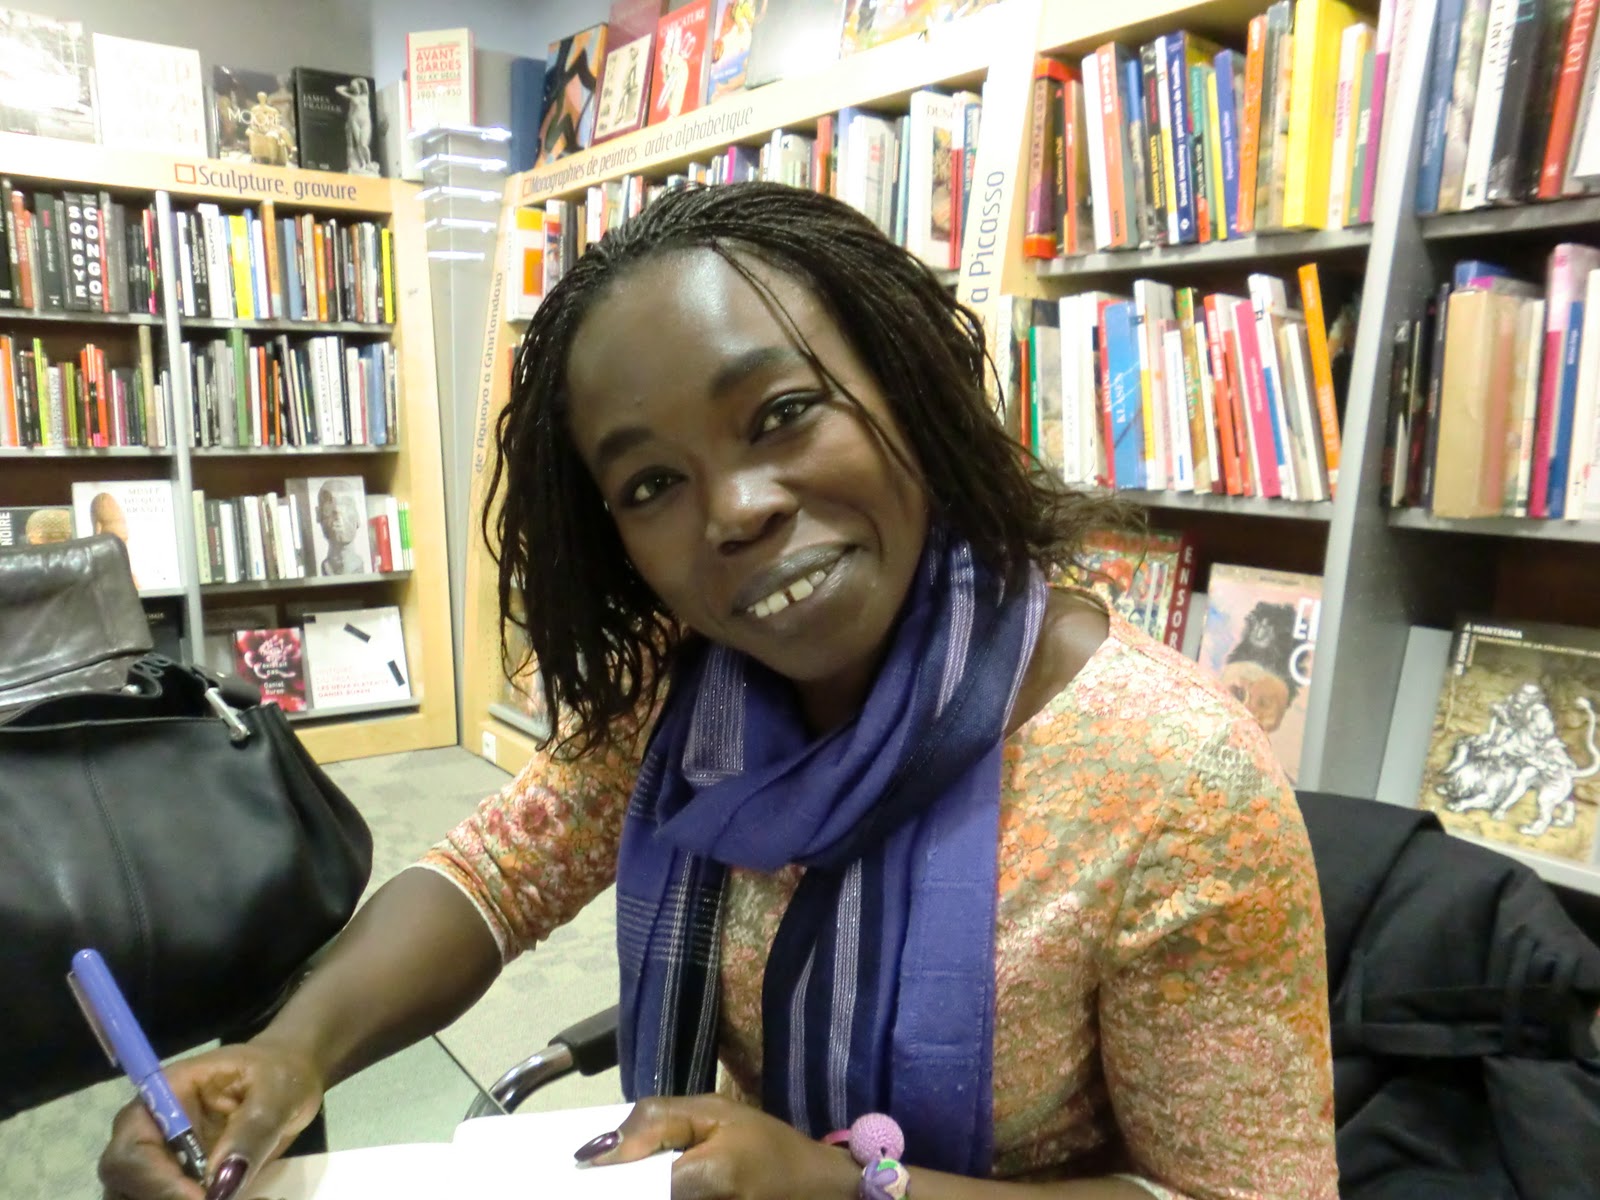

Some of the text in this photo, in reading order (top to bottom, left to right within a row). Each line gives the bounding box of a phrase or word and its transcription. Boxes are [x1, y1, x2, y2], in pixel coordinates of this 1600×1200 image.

[416, 60, 461, 75] GARDES
[228, 106, 282, 127] MOORE
[586, 157, 599, 176] de
[599, 143, 638, 171] peintres
[644, 132, 673, 157] ordre
[294, 180, 358, 201] gravure
[968, 170, 1005, 277] Picasso
[68, 205, 87, 298] SONGYE
[82, 206, 103, 295] CONGO
[1111, 372, 1127, 425] KLASEN
[0, 511, 14, 546] NOIRE
[1168, 544, 1194, 650] ENSOR
